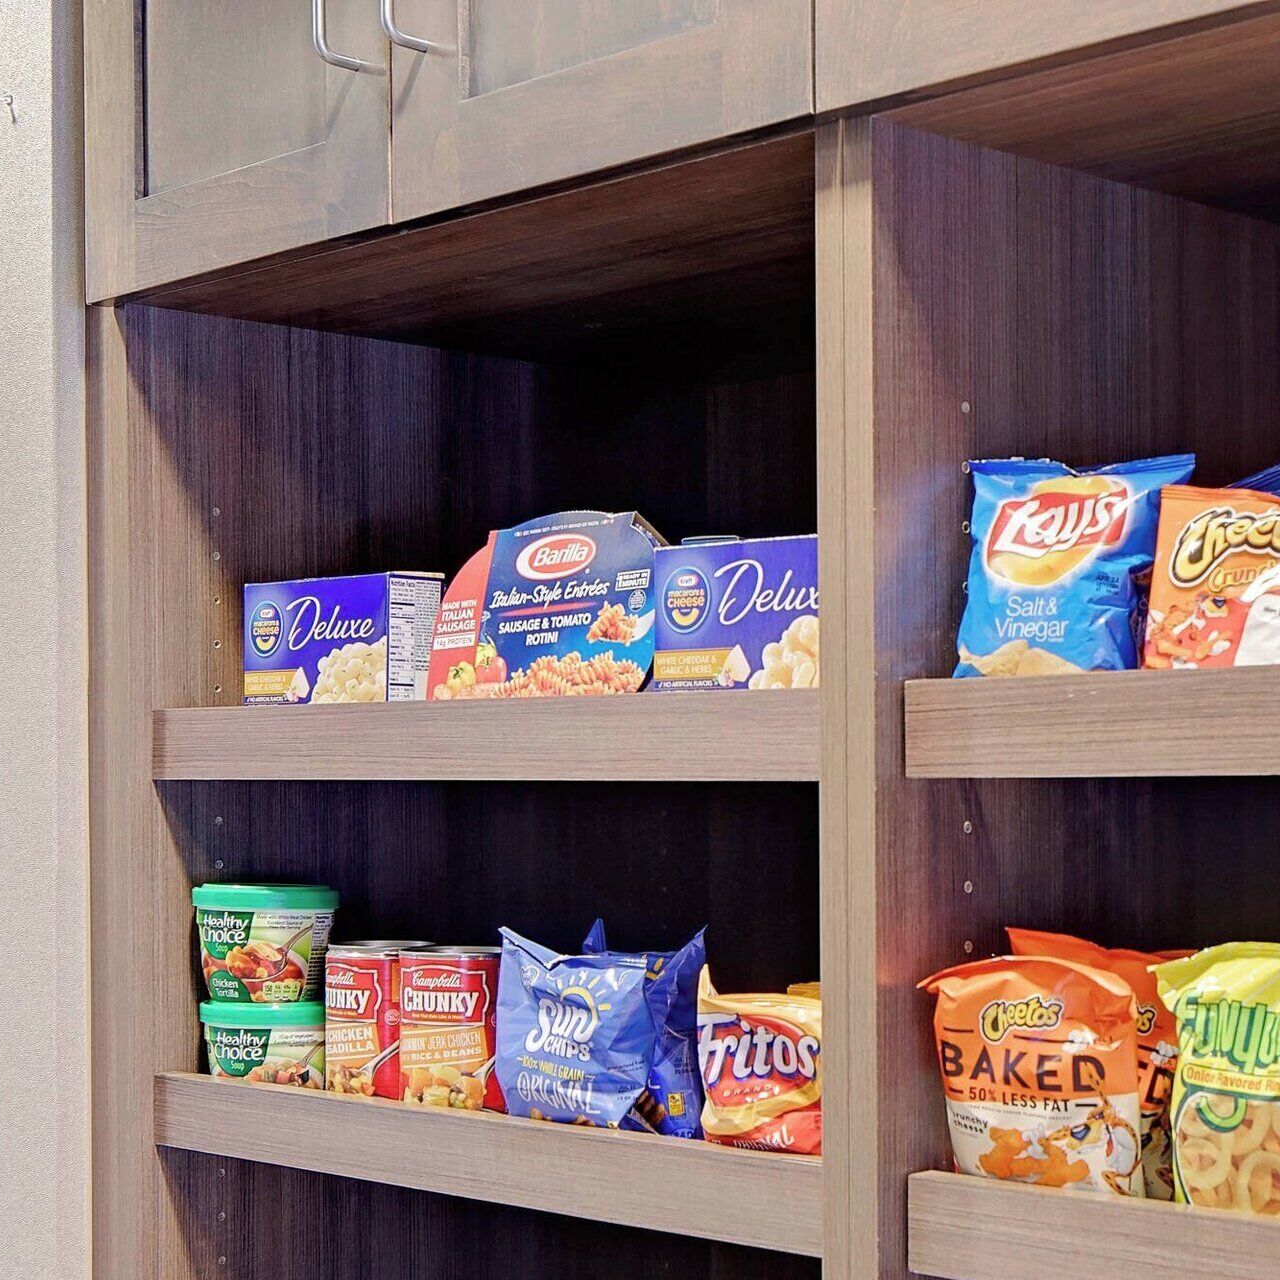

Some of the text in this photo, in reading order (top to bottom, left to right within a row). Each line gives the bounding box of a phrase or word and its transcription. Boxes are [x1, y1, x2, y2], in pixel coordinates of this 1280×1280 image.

[994, 489, 1128, 558] Lay's
[533, 541, 589, 568] Barilla
[489, 579, 611, 609] Italian-Style Entrées
[713, 559, 819, 625] Delux
[441, 609, 474, 621] ITALIAN
[442, 600, 477, 611] MADE WITH
[1006, 596, 1058, 617] Salt &
[286, 596, 375, 651] Deluxe
[436, 620, 476, 633] SAUSAGE
[498, 613, 591, 634] SAUSAGE & TOMATO
[995, 616, 1068, 643] Vinegar
[447, 636, 473, 646] PROTEIN
[525, 631, 558, 646] ROTINI
[204, 912, 249, 931] Healthy
[202, 924, 245, 944] Choice
[212, 977, 239, 989] Chicken
[412, 970, 463, 989] Campbell's
[215, 987, 240, 999] Tortilla
[326, 990, 371, 1014] UNKY
[404, 987, 479, 1017] CHUNKY
[981, 996, 1063, 1043] Cheetos
[216, 1029, 267, 1047] Healthy
[327, 1026, 373, 1041] CHICKEN
[427, 1031, 481, 1050] JERK CHICKEN
[215, 1043, 262, 1061] Choice
[411, 1047, 482, 1061] RICE & BEANS
[544, 1039, 591, 1062] CHIPS
[699, 1014, 820, 1086] Fritos
[230, 1060, 245, 1071] Soup
[539, 1059, 557, 1076] WHOLE
[558, 1064, 584, 1082] GRAIN
[941, 1040, 1106, 1093] BAKED
[968, 1087, 1071, 1112] 50% LESS FAT
[952, 1109, 990, 1129] crunchy
[953, 1120, 985, 1135] cheese
